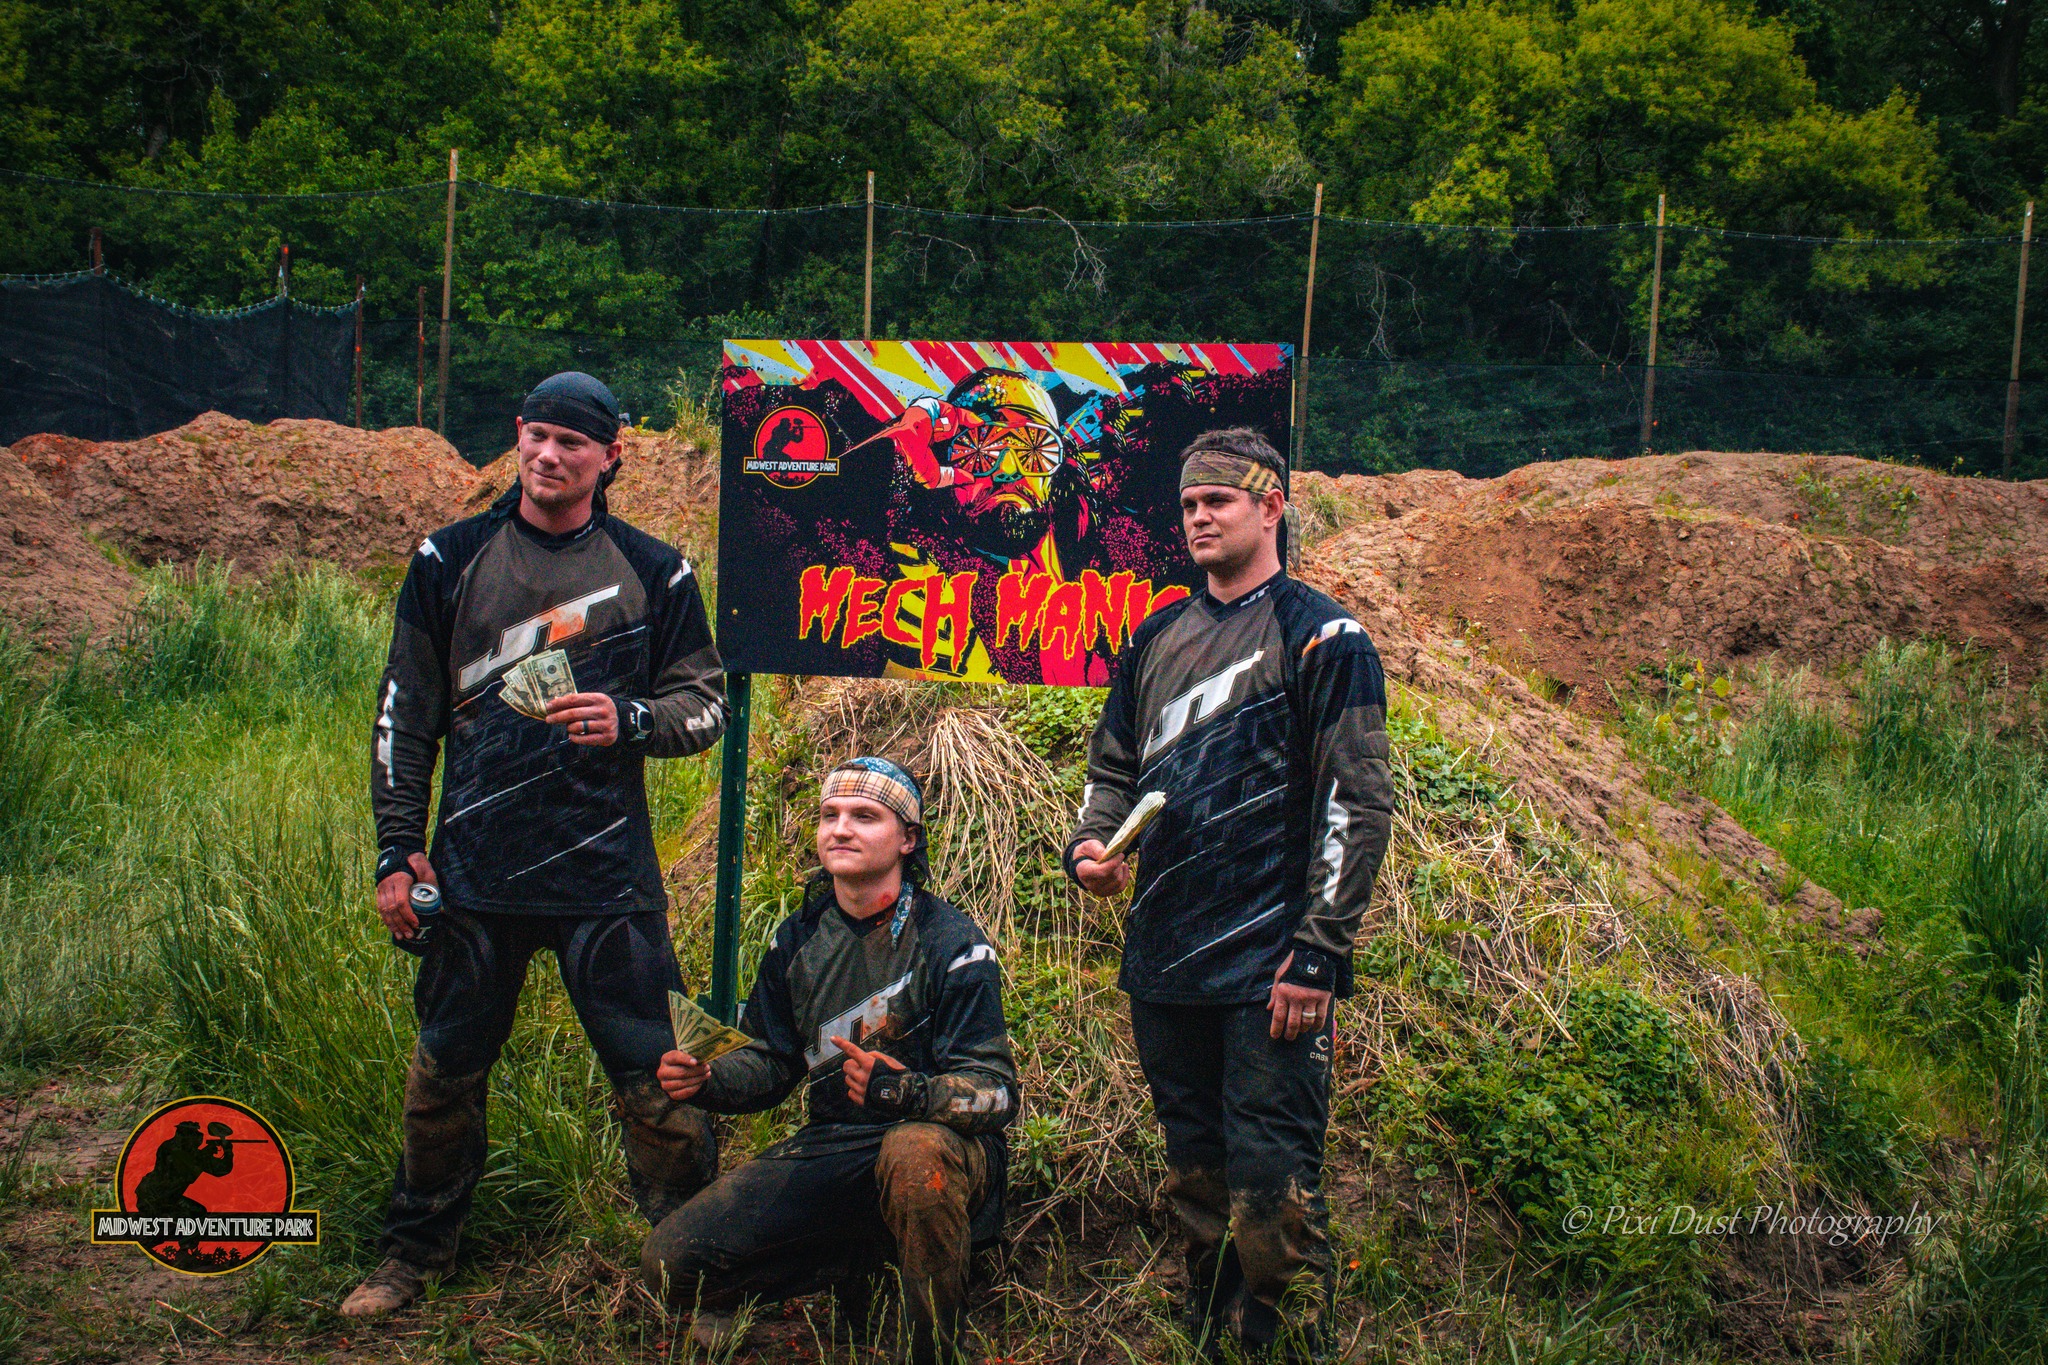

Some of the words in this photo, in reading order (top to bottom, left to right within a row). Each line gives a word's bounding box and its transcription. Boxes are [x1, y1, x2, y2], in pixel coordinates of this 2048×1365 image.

[746, 460, 778, 471] MIDWEST
[778, 460, 820, 472] ADVENTURE
[820, 462, 837, 472] PARK
[457, 582, 622, 692] JT
[799, 565, 978, 673] MECH
[1240, 584, 1270, 607] JT
[1140, 648, 1267, 765] JT
[1321, 776, 1350, 906] JT
